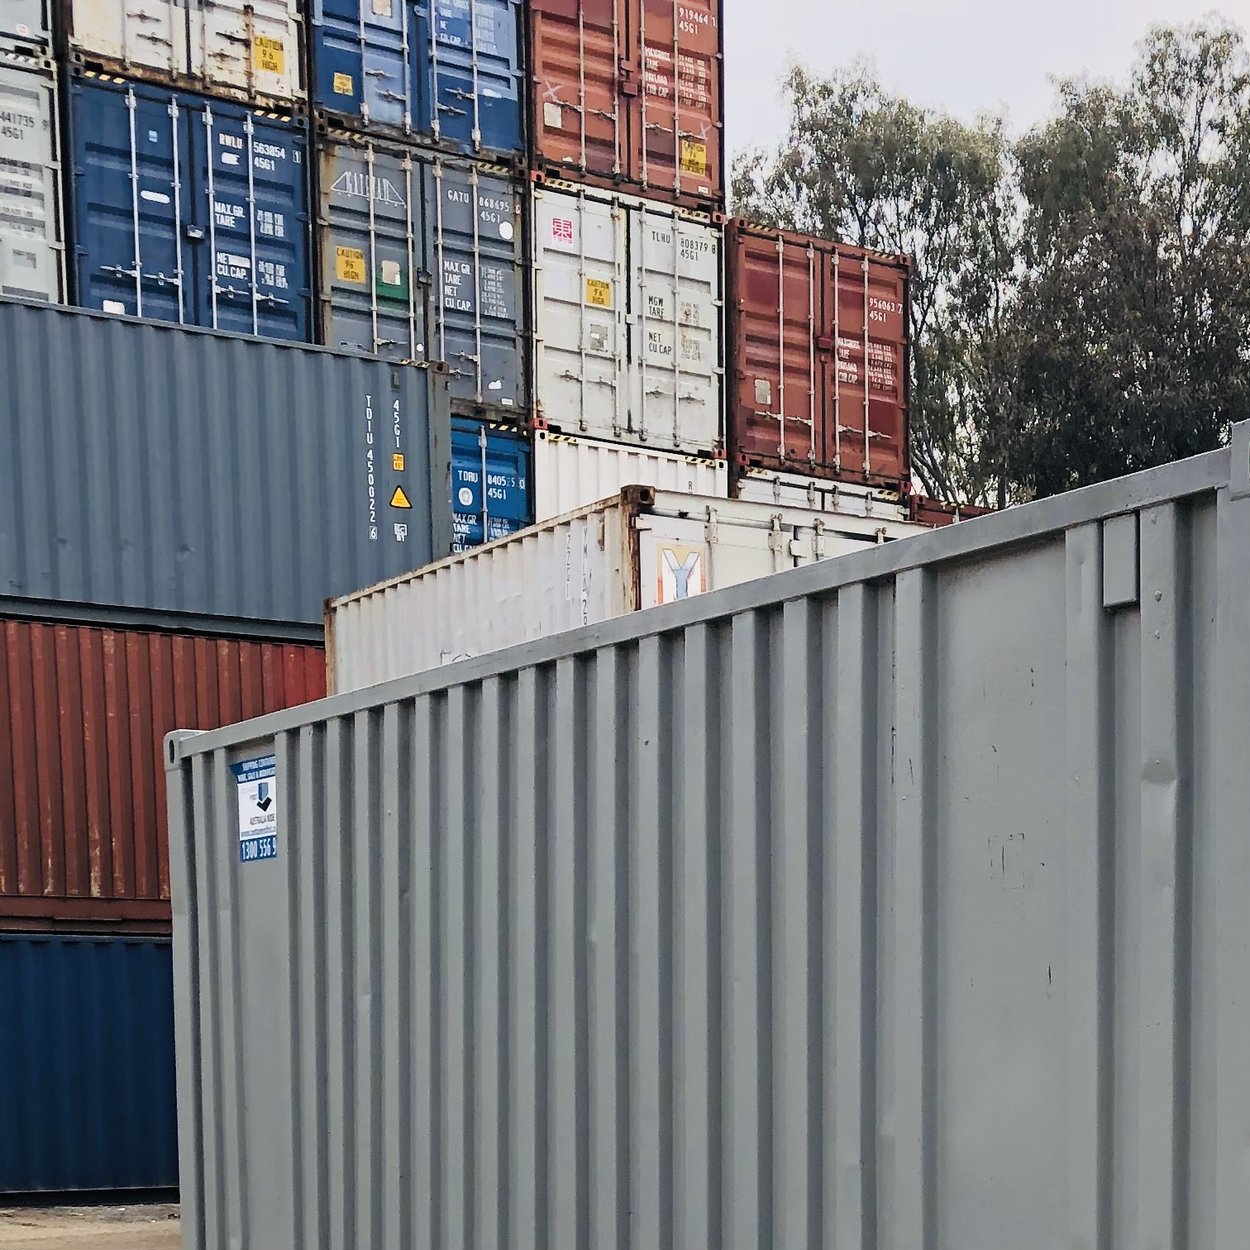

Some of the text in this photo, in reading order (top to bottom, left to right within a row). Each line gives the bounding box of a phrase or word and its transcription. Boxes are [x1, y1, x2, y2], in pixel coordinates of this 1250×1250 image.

[679, 7, 708, 25] 919464
[679, 20, 698, 35] 45G1
[254, 156, 275, 171] 45G1
[447, 189, 470, 203] GATU
[480, 210, 500, 223] 45G1
[680, 249, 699, 260] 45G1
[869, 297, 895, 312] 956063
[869, 310, 887, 322] 45G1
[365, 394, 374, 445] TDIU
[393, 399, 401, 448] 45G1
[366, 449, 376, 523] 450022
[487, 487, 507, 500] 45G1
[242, 840, 258, 860] 1300
[259, 837, 271, 857] 556
